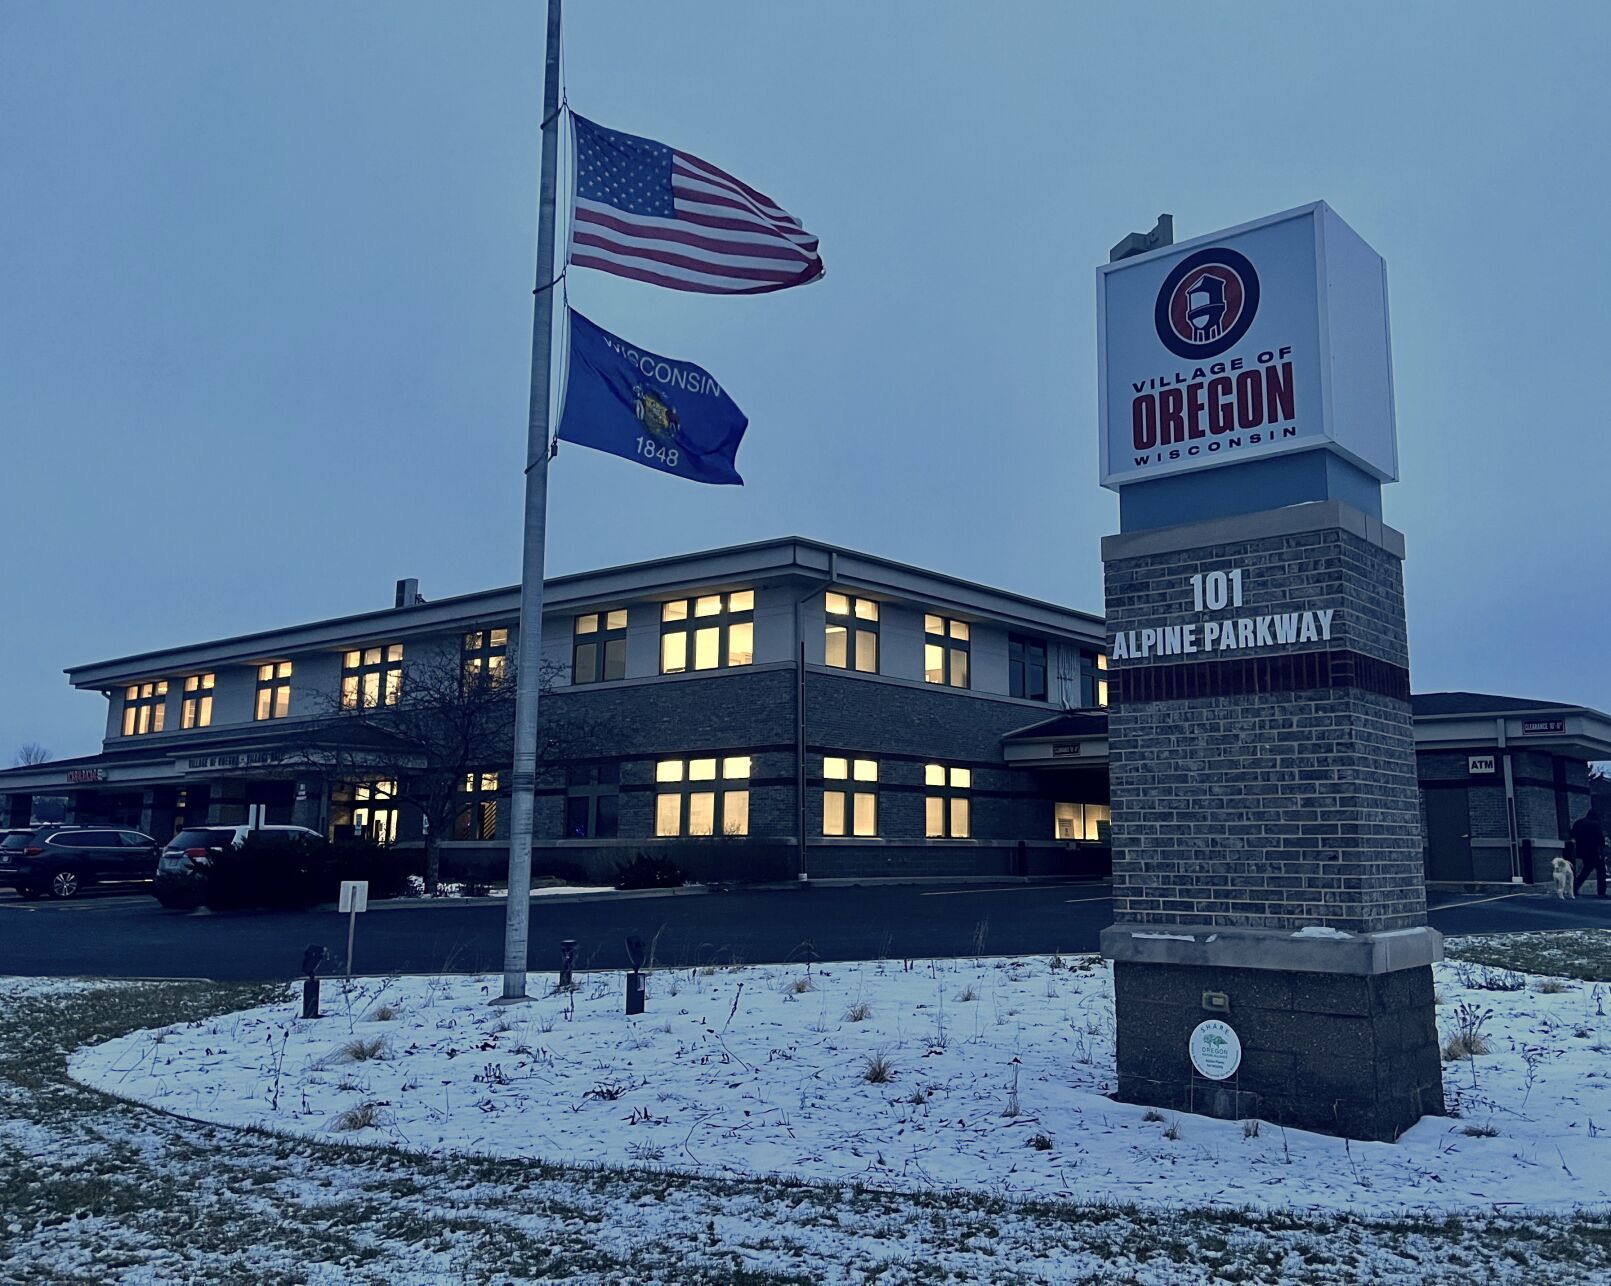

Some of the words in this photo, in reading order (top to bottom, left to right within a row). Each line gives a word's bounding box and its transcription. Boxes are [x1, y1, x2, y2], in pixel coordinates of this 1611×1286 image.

[1132, 357, 1244, 393] VILLAGE
[1256, 346, 1292, 364] OF
[1132, 361, 1295, 451] OREGON
[635, 436, 679, 467] 1848
[1134, 426, 1296, 466] WISCONSIN
[1189, 568, 1243, 612] 101
[1112, 624, 1197, 660] ALPINE
[1204, 609, 1334, 651] PARKWAY
[1471, 759, 1493, 770] ATM
[1200, 1023, 1230, 1035] SHARE
[1201, 1047, 1228, 1055] OREGON
